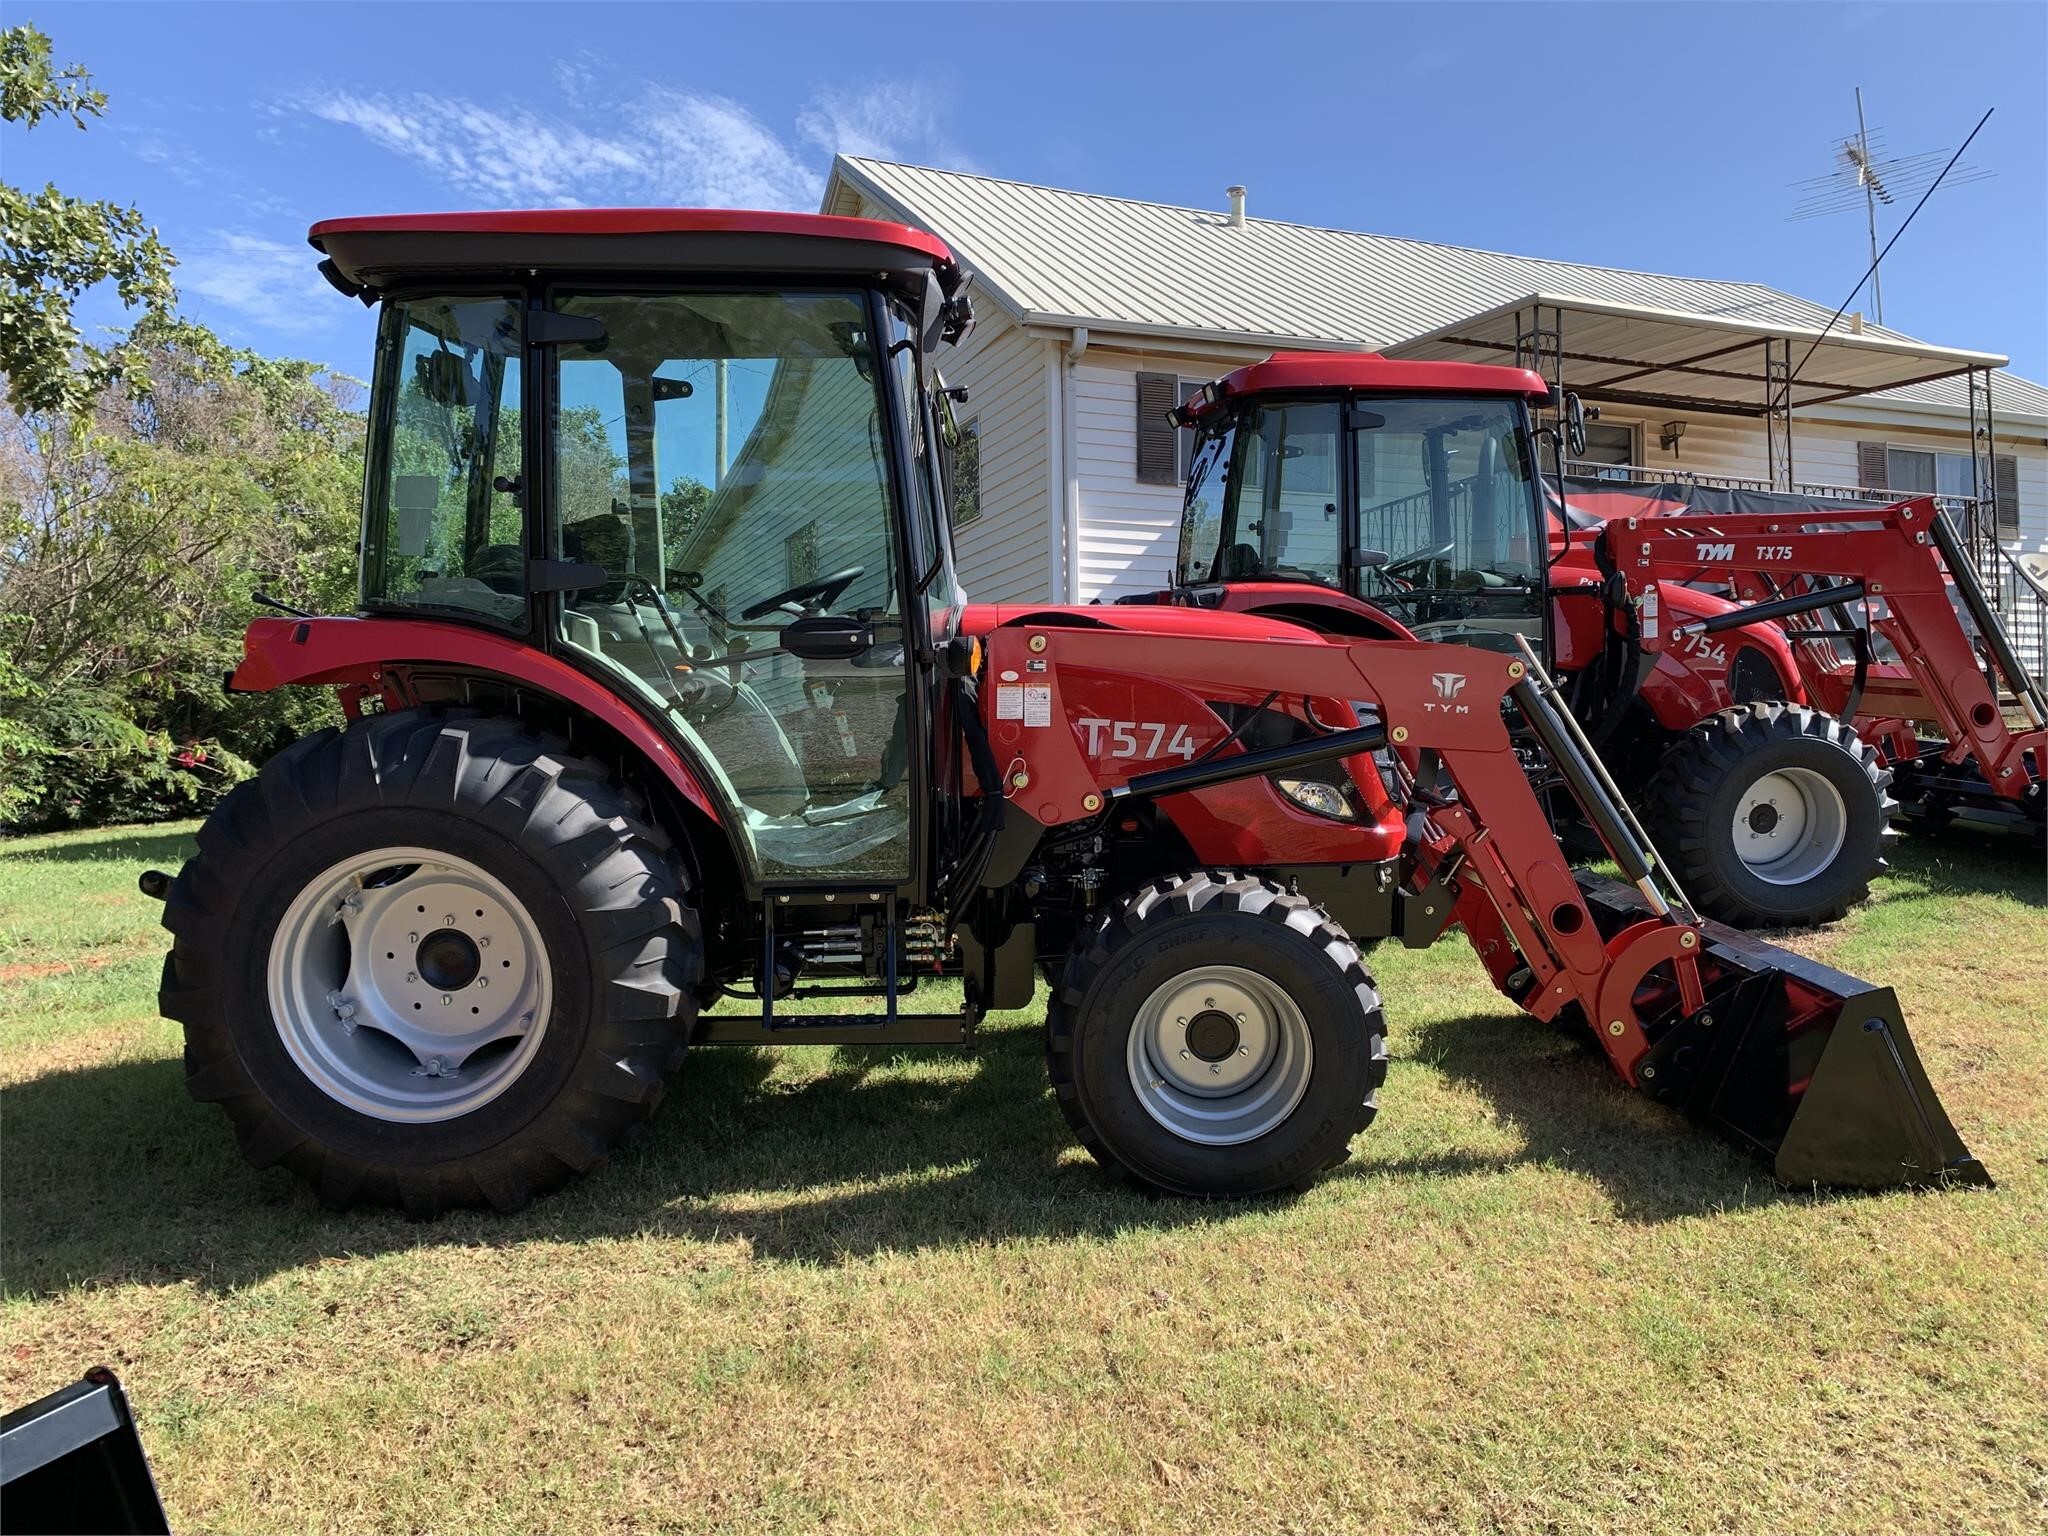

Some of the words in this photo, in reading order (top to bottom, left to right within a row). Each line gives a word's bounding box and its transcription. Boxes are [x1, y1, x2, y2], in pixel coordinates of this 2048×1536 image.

[1696, 543, 1735, 560] TYM
[1670, 633, 1726, 665] 754
[1423, 702, 1469, 714] TYM
[1078, 718, 1196, 761] T574
